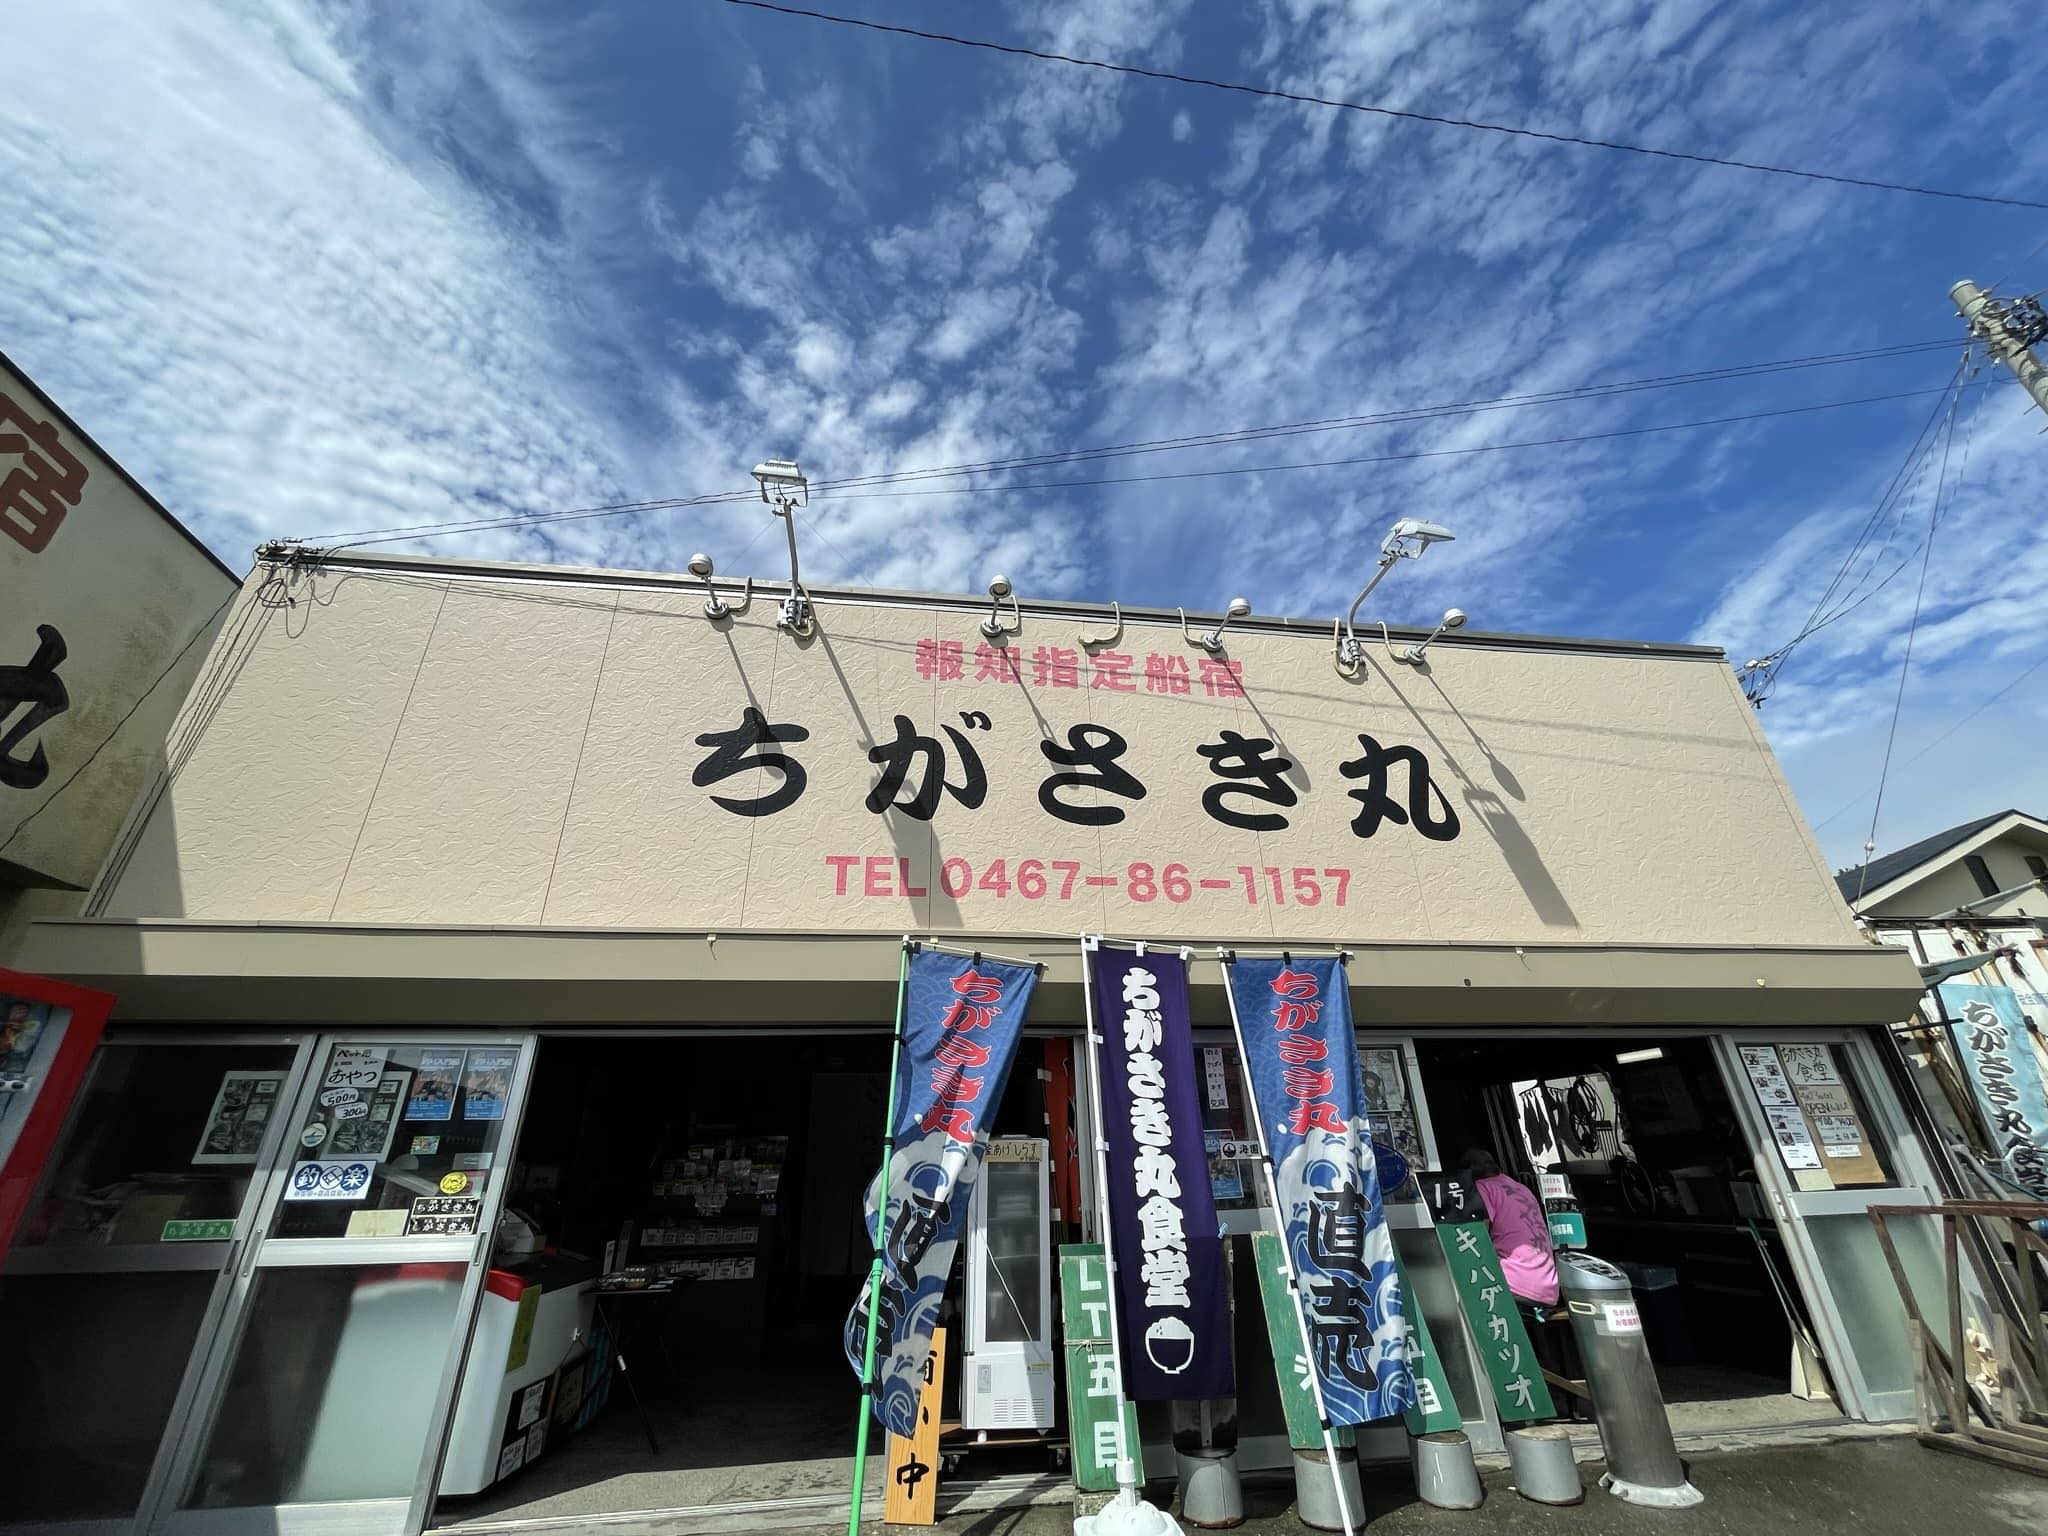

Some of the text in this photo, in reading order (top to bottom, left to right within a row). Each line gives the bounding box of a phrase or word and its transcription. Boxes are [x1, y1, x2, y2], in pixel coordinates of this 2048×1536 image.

[914, 636, 1245, 698] 報知指定船宿
[692, 706, 1461, 842] ちがさき丸
[825, 855, 929, 899] TEL
[328, 1068, 377, 1085] おやつ
[921, 969, 1004, 1144] ちがさき丸
[1268, 969, 1348, 1136] ちがさき丸
[1122, 967, 1191, 1308] ちがさき丸食堂
[1454, 1227, 1537, 1413] キハダカツオ
